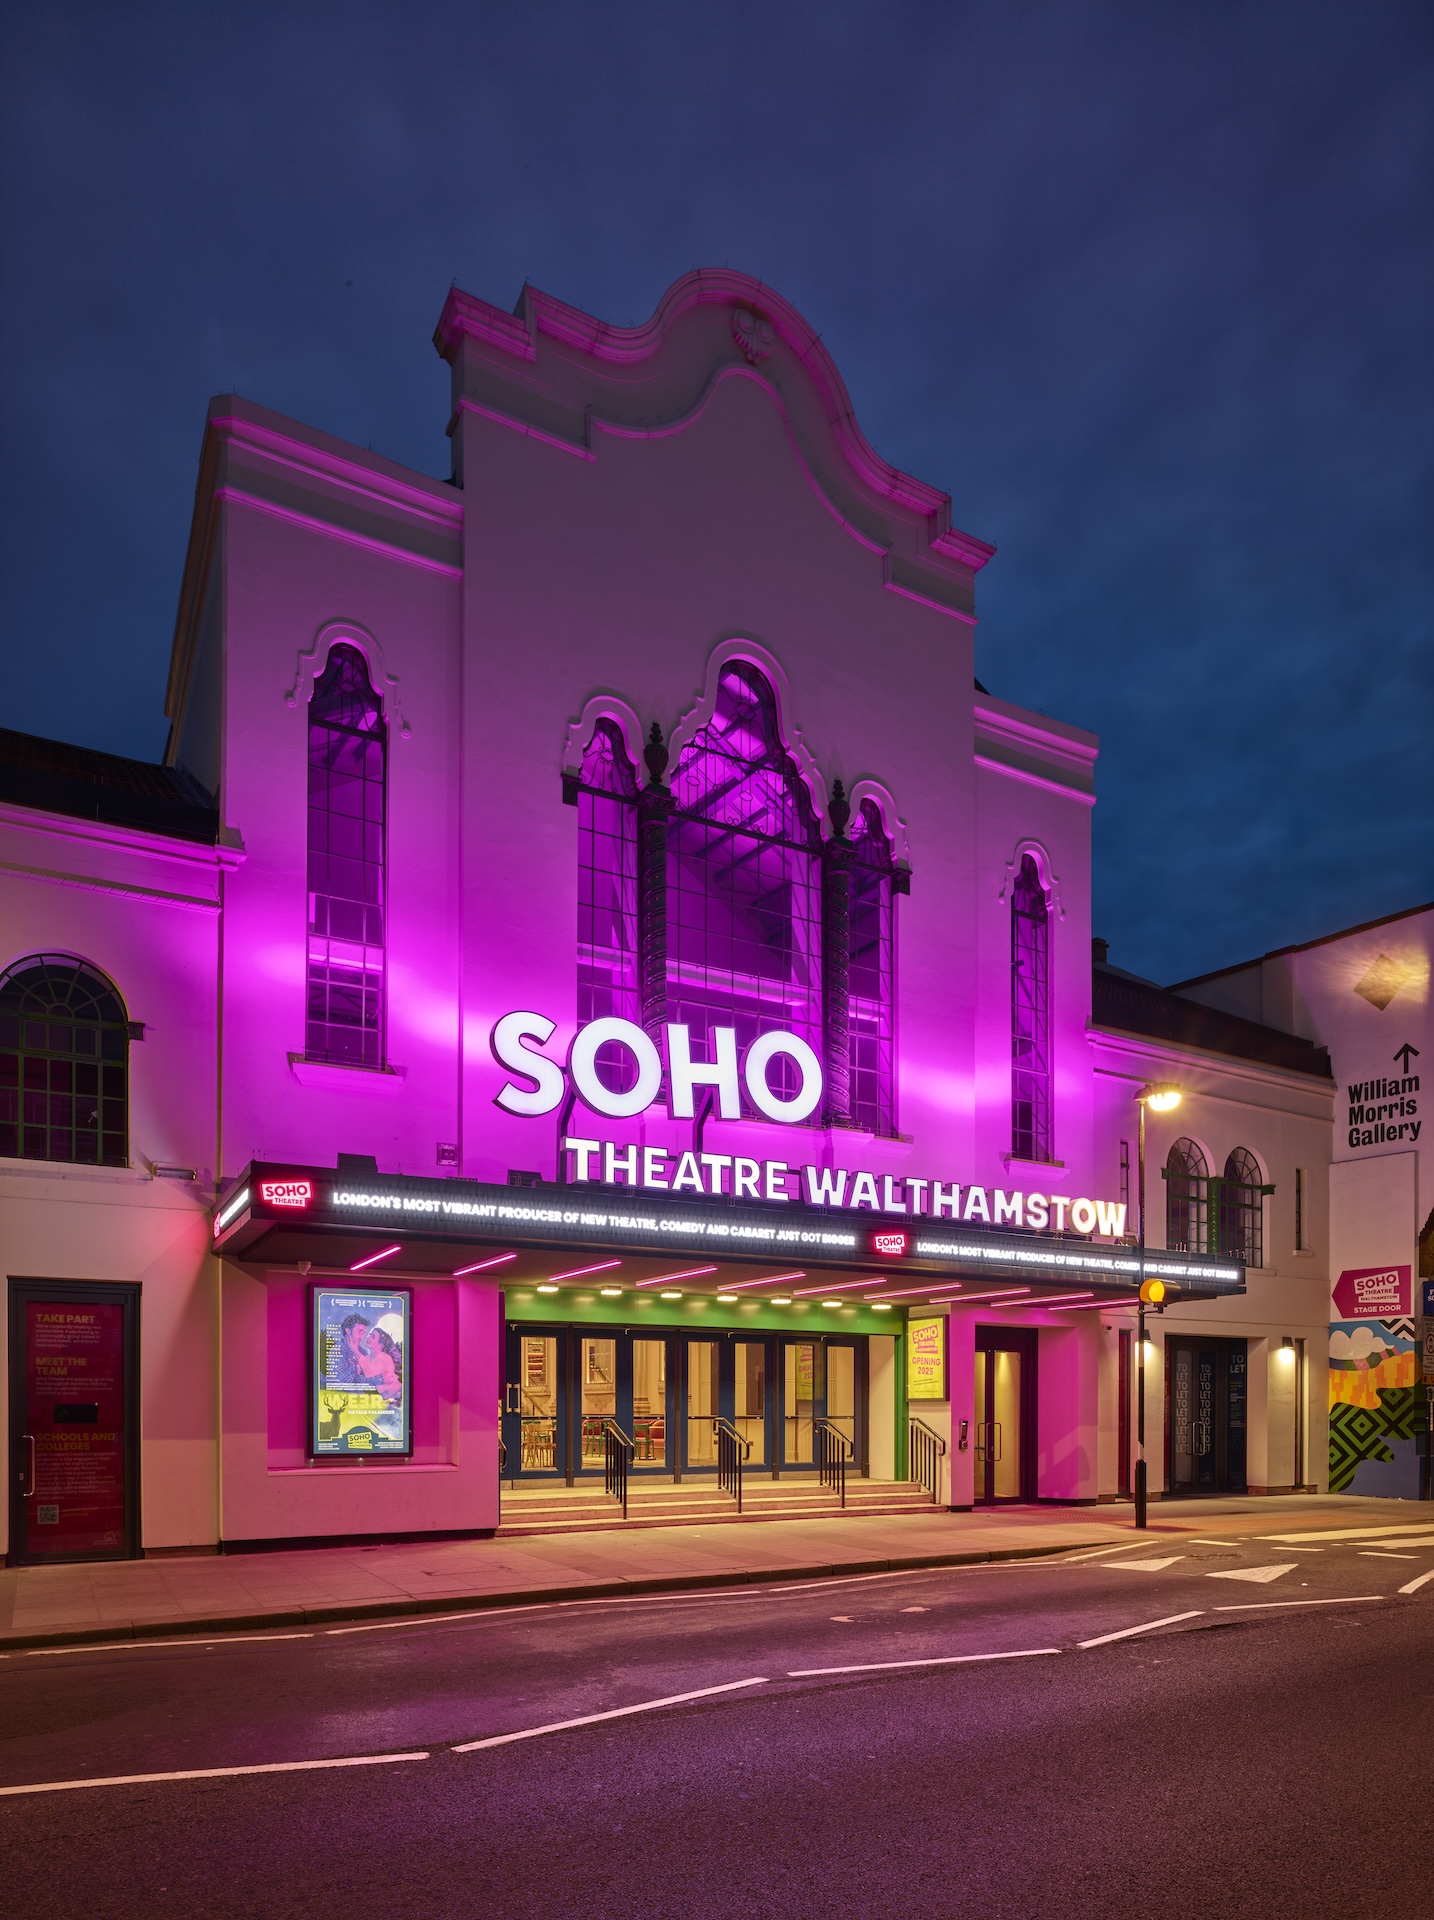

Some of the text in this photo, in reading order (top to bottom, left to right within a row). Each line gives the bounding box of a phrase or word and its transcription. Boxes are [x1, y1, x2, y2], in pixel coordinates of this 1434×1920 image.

[490, 1010, 823, 1123] SOHO
[1348, 1076, 1419, 1104] William
[1349, 1097, 1417, 1126] Morris
[1349, 1121, 1421, 1147] Gallery
[265, 1184, 307, 1197] SOHO
[563, 1136, 1127, 1237] THEATRE WALTHAMSTOW
[333, 1192, 855, 1245] LONDON'S MOST VIBRANT PRODUCER OF NEW THEATRE, COMEDY AND CABARET JUST GOT BIGGER
[877, 1236, 902, 1246] SOHO
[918, 1243, 958, 1255] LONDON'S
[959, 1246, 982, 1256] MOST
[983, 1248, 1015, 1260] VIBRANT
[1017, 1251, 1055, 1263] PRODUCER
[1056, 1255, 1065, 1264] OF
[1357, 1274, 1396, 1290] SOHO
[36, 1314, 95, 1323] TAKE PART
[913, 1326, 937, 1343] SOHO
[36, 1357, 87, 1366] MEET THE
[912, 1357, 940, 1366] OPENING
[1231, 1355, 1244, 1363] TO
[36, 1367, 67, 1375] TEAM
[918, 1367, 933, 1375] 2025
[1177, 1364, 1187, 1372] TO
[1200, 1364, 1211, 1372] TO
[1230, 1365, 1245, 1373] LET
[1176, 1372, 1188, 1380] LET
[1200, 1373, 1211, 1381] LET
[1177, 1382, 1187, 1390] TO
[1200, 1382, 1211, 1390] TO
[1200, 1391, 1211, 1399] LET
[1177, 1400, 1187, 1408] TO
[1200, 1400, 1211, 1408] TO
[1176, 1408, 1188, 1416] LET
[1200, 1408, 1211, 1416] LET
[1177, 1417, 1187, 1425] TO
[1200, 1417, 1211, 1425] TO
[1176, 1426, 1188, 1434] LET
[350, 1433, 370, 1441] SOHO
[1177, 1435, 1187, 1443] TO
[1176, 1444, 1188, 1452] LET
